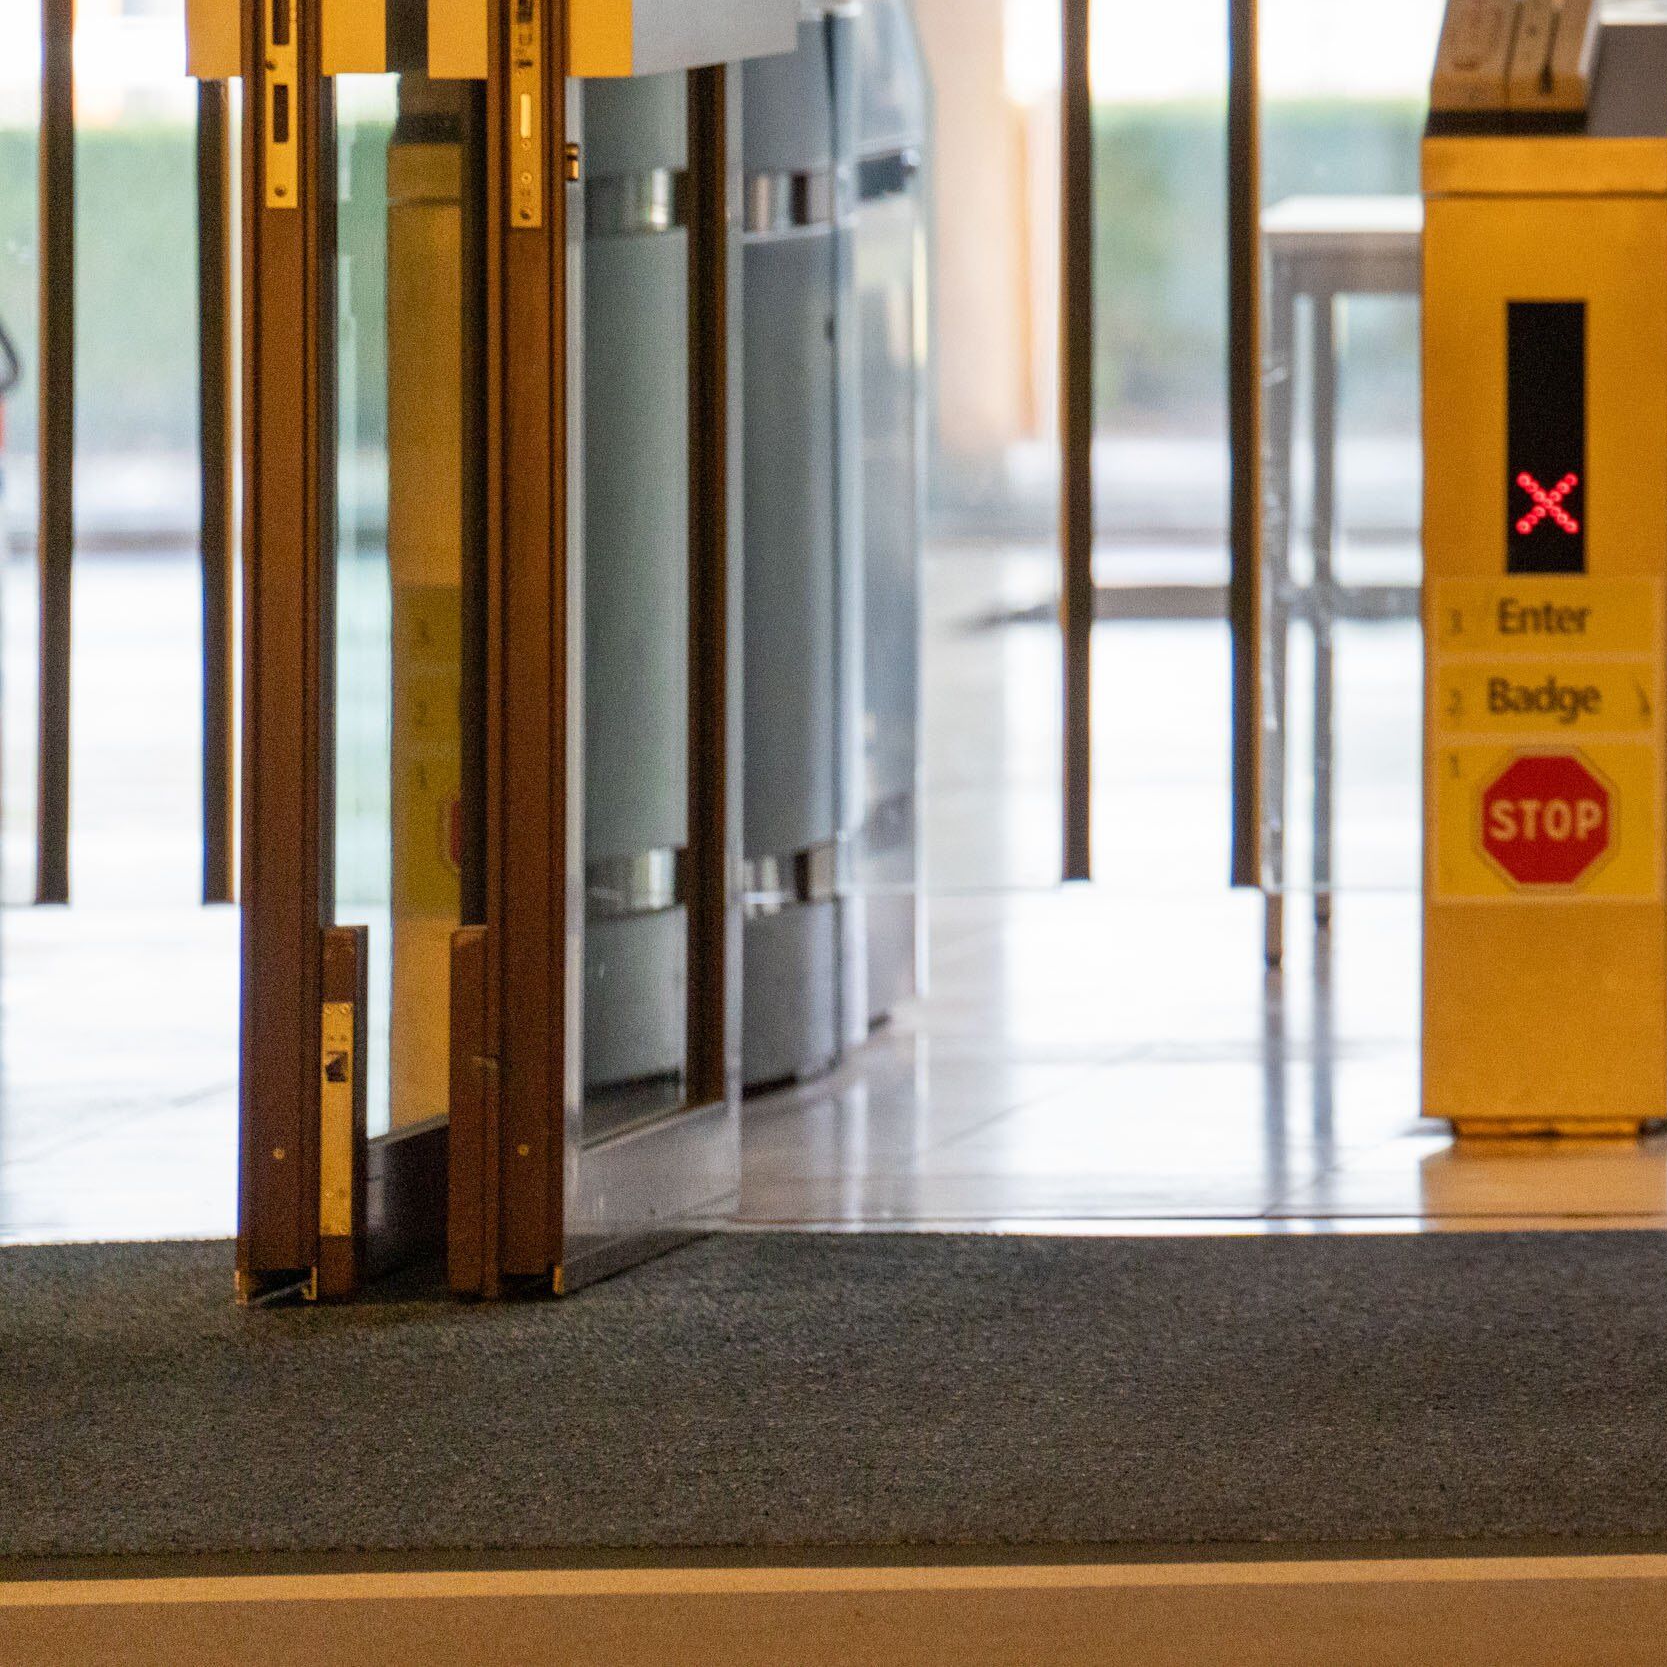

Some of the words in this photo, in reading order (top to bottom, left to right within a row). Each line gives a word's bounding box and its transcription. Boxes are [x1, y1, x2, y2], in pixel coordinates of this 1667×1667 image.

[1496, 597, 1591, 635] Enter
[1487, 675, 1602, 726] Badge
[1488, 798, 1603, 842] STOP
